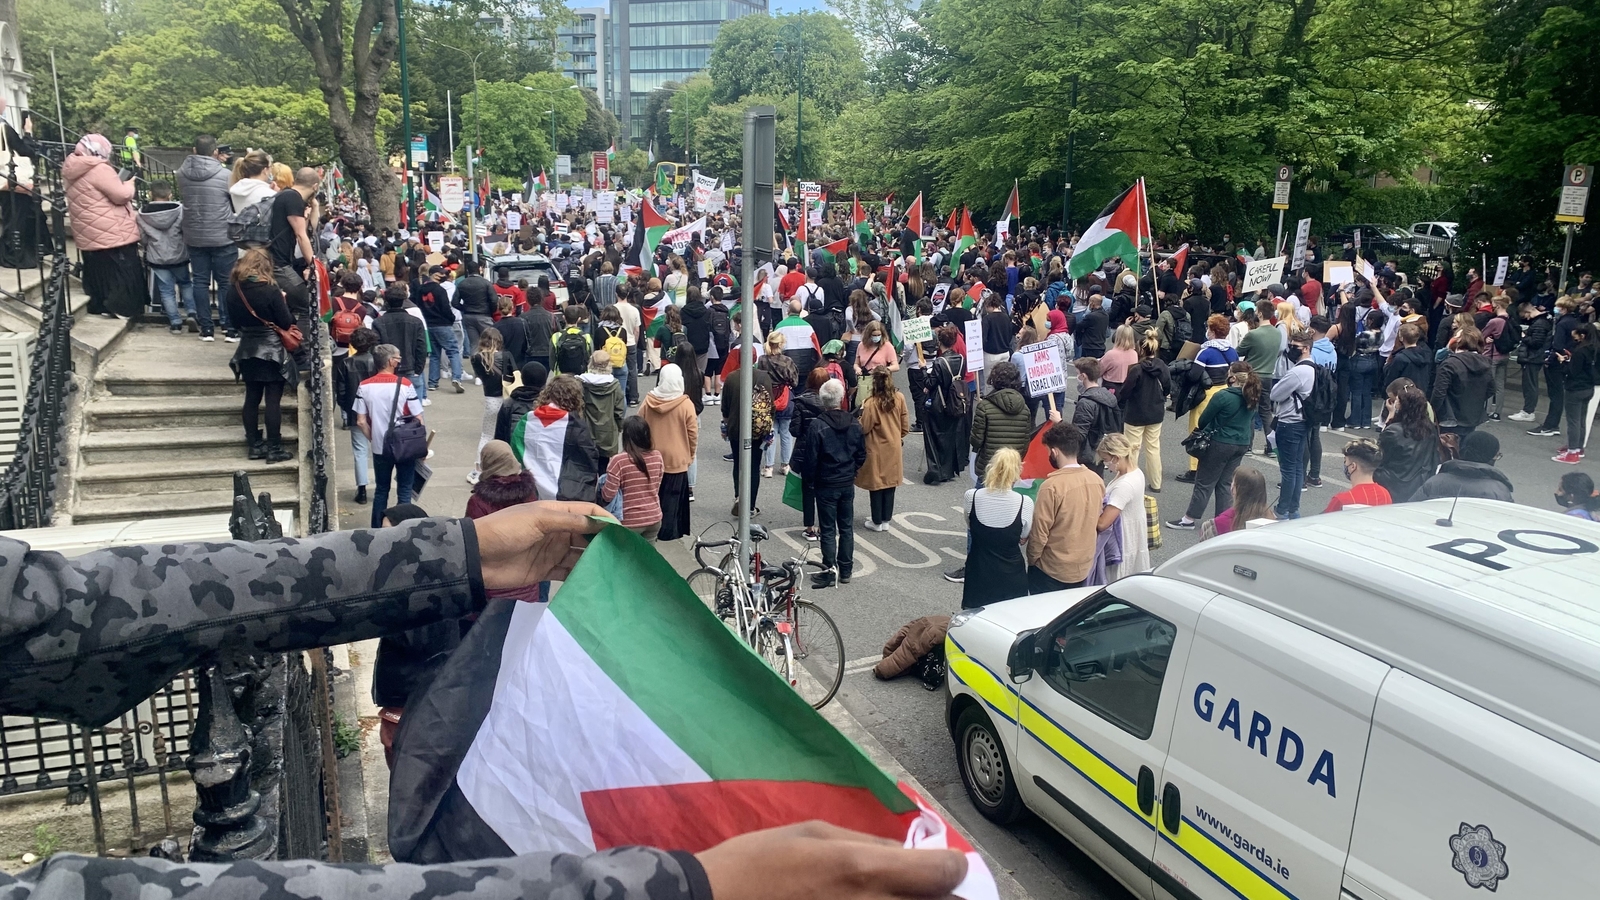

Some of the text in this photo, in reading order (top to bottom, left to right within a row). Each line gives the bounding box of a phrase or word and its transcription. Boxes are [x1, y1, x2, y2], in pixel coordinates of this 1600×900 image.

[1248, 262, 1279, 277] CAREFUL
[1034, 350, 1050, 364] ARMS
[1028, 362, 1055, 379] EMBARGO
[1030, 377, 1050, 392] ISRAEL
[1050, 374, 1064, 387] NOW
[1193, 682, 1337, 799] GARDA
[1195, 804, 1290, 880] www.garda.ie
